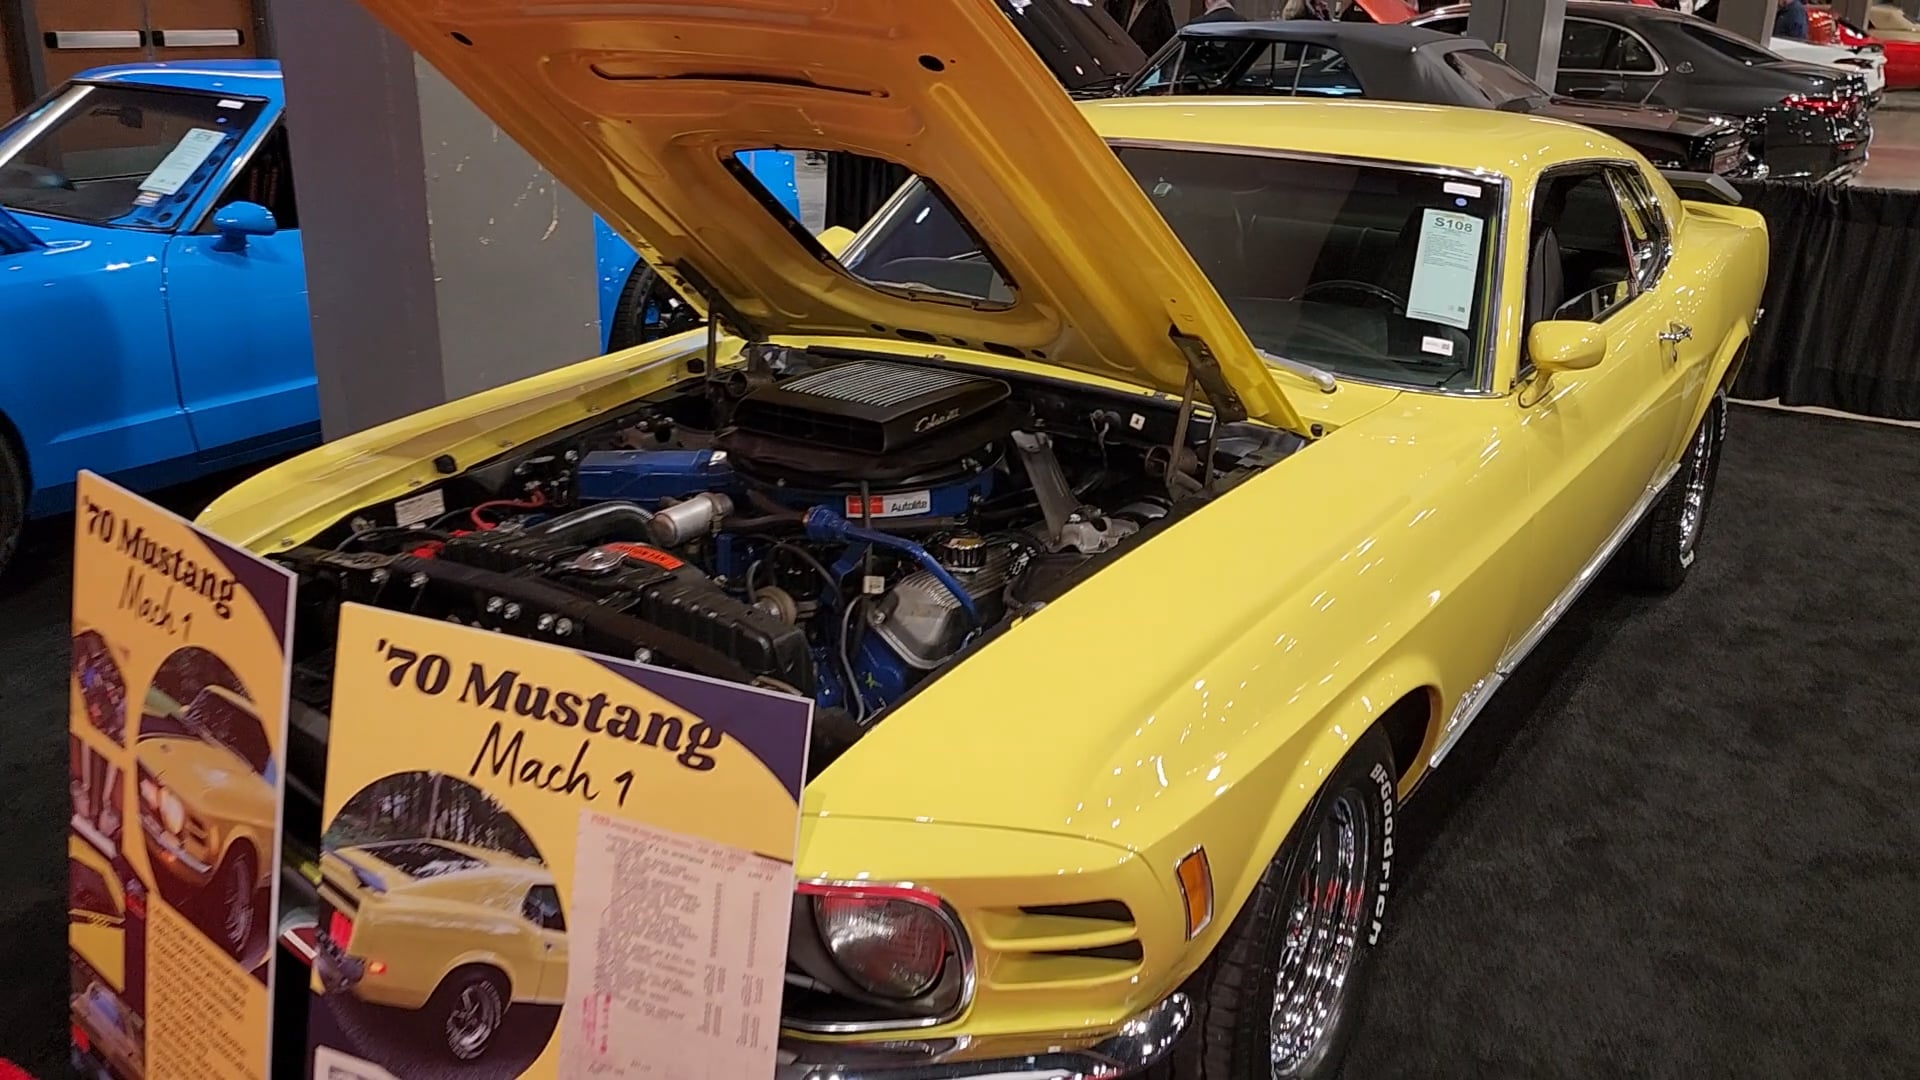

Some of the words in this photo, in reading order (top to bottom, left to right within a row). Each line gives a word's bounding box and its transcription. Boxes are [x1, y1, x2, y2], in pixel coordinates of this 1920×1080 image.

[1434, 217, 1474, 233] S108
[116, 518, 238, 620] Mustang
[118, 564, 177, 636] Mach
[182, 612, 194, 643] 1
[376, 639, 452, 696] '70
[458, 663, 727, 771] Mustang
[468, 722, 600, 801] Mach
[613, 771, 636, 807] 1
[1368, 763, 1395, 946] BFGoodrich
